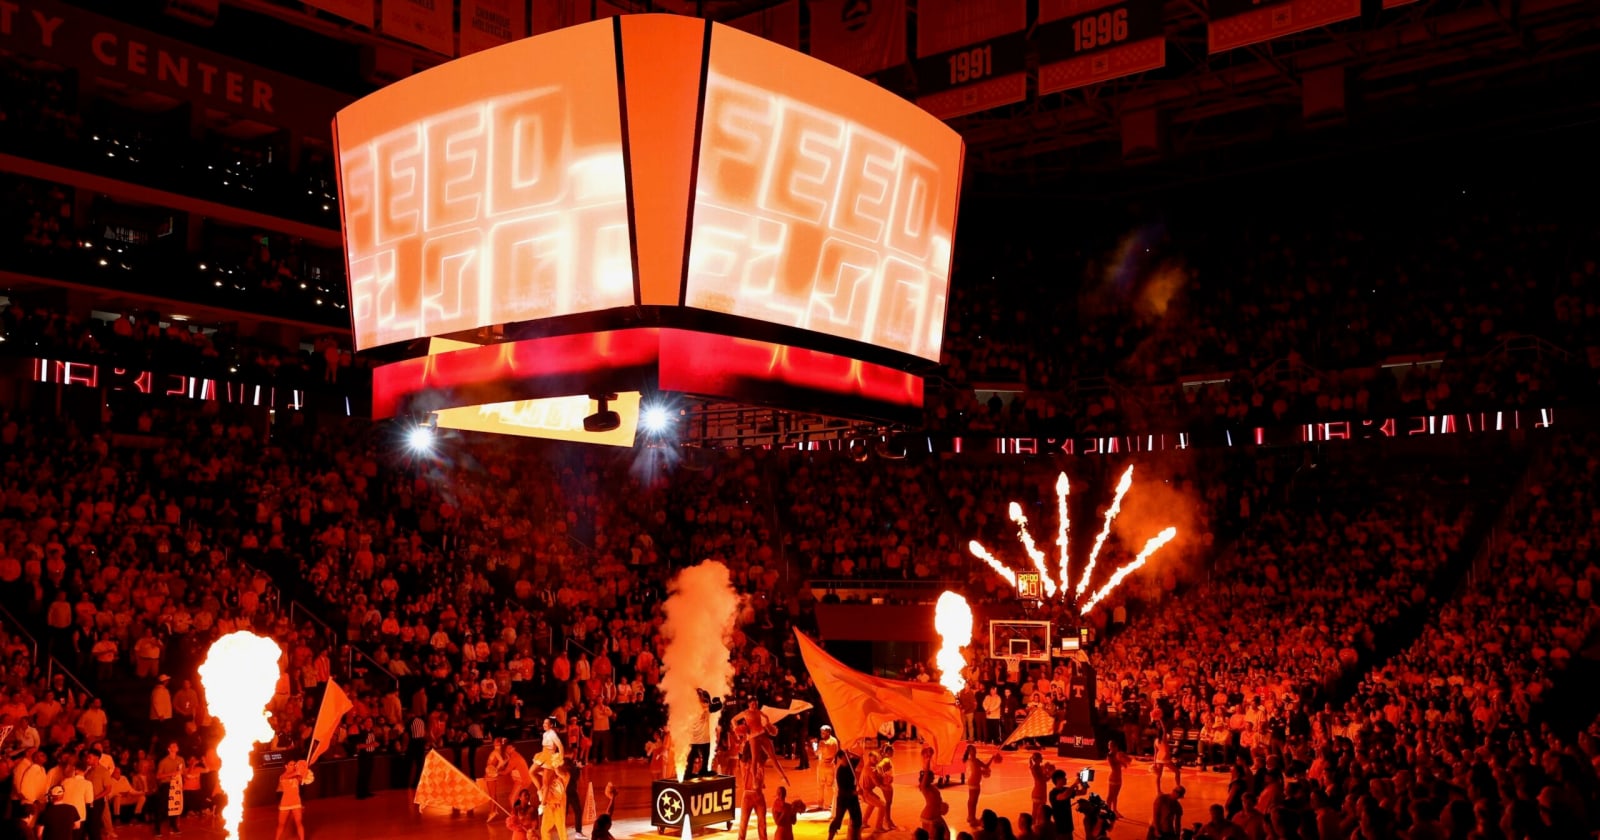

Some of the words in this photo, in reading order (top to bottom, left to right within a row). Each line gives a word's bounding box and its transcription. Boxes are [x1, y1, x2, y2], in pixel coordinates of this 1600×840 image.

[1071, 7, 1129, 53] 1996
[91, 31, 275, 112] CENTER
[949, 46, 993, 84] 1991
[1072, 685, 1085, 698] T
[690, 788, 733, 817] VOLS
